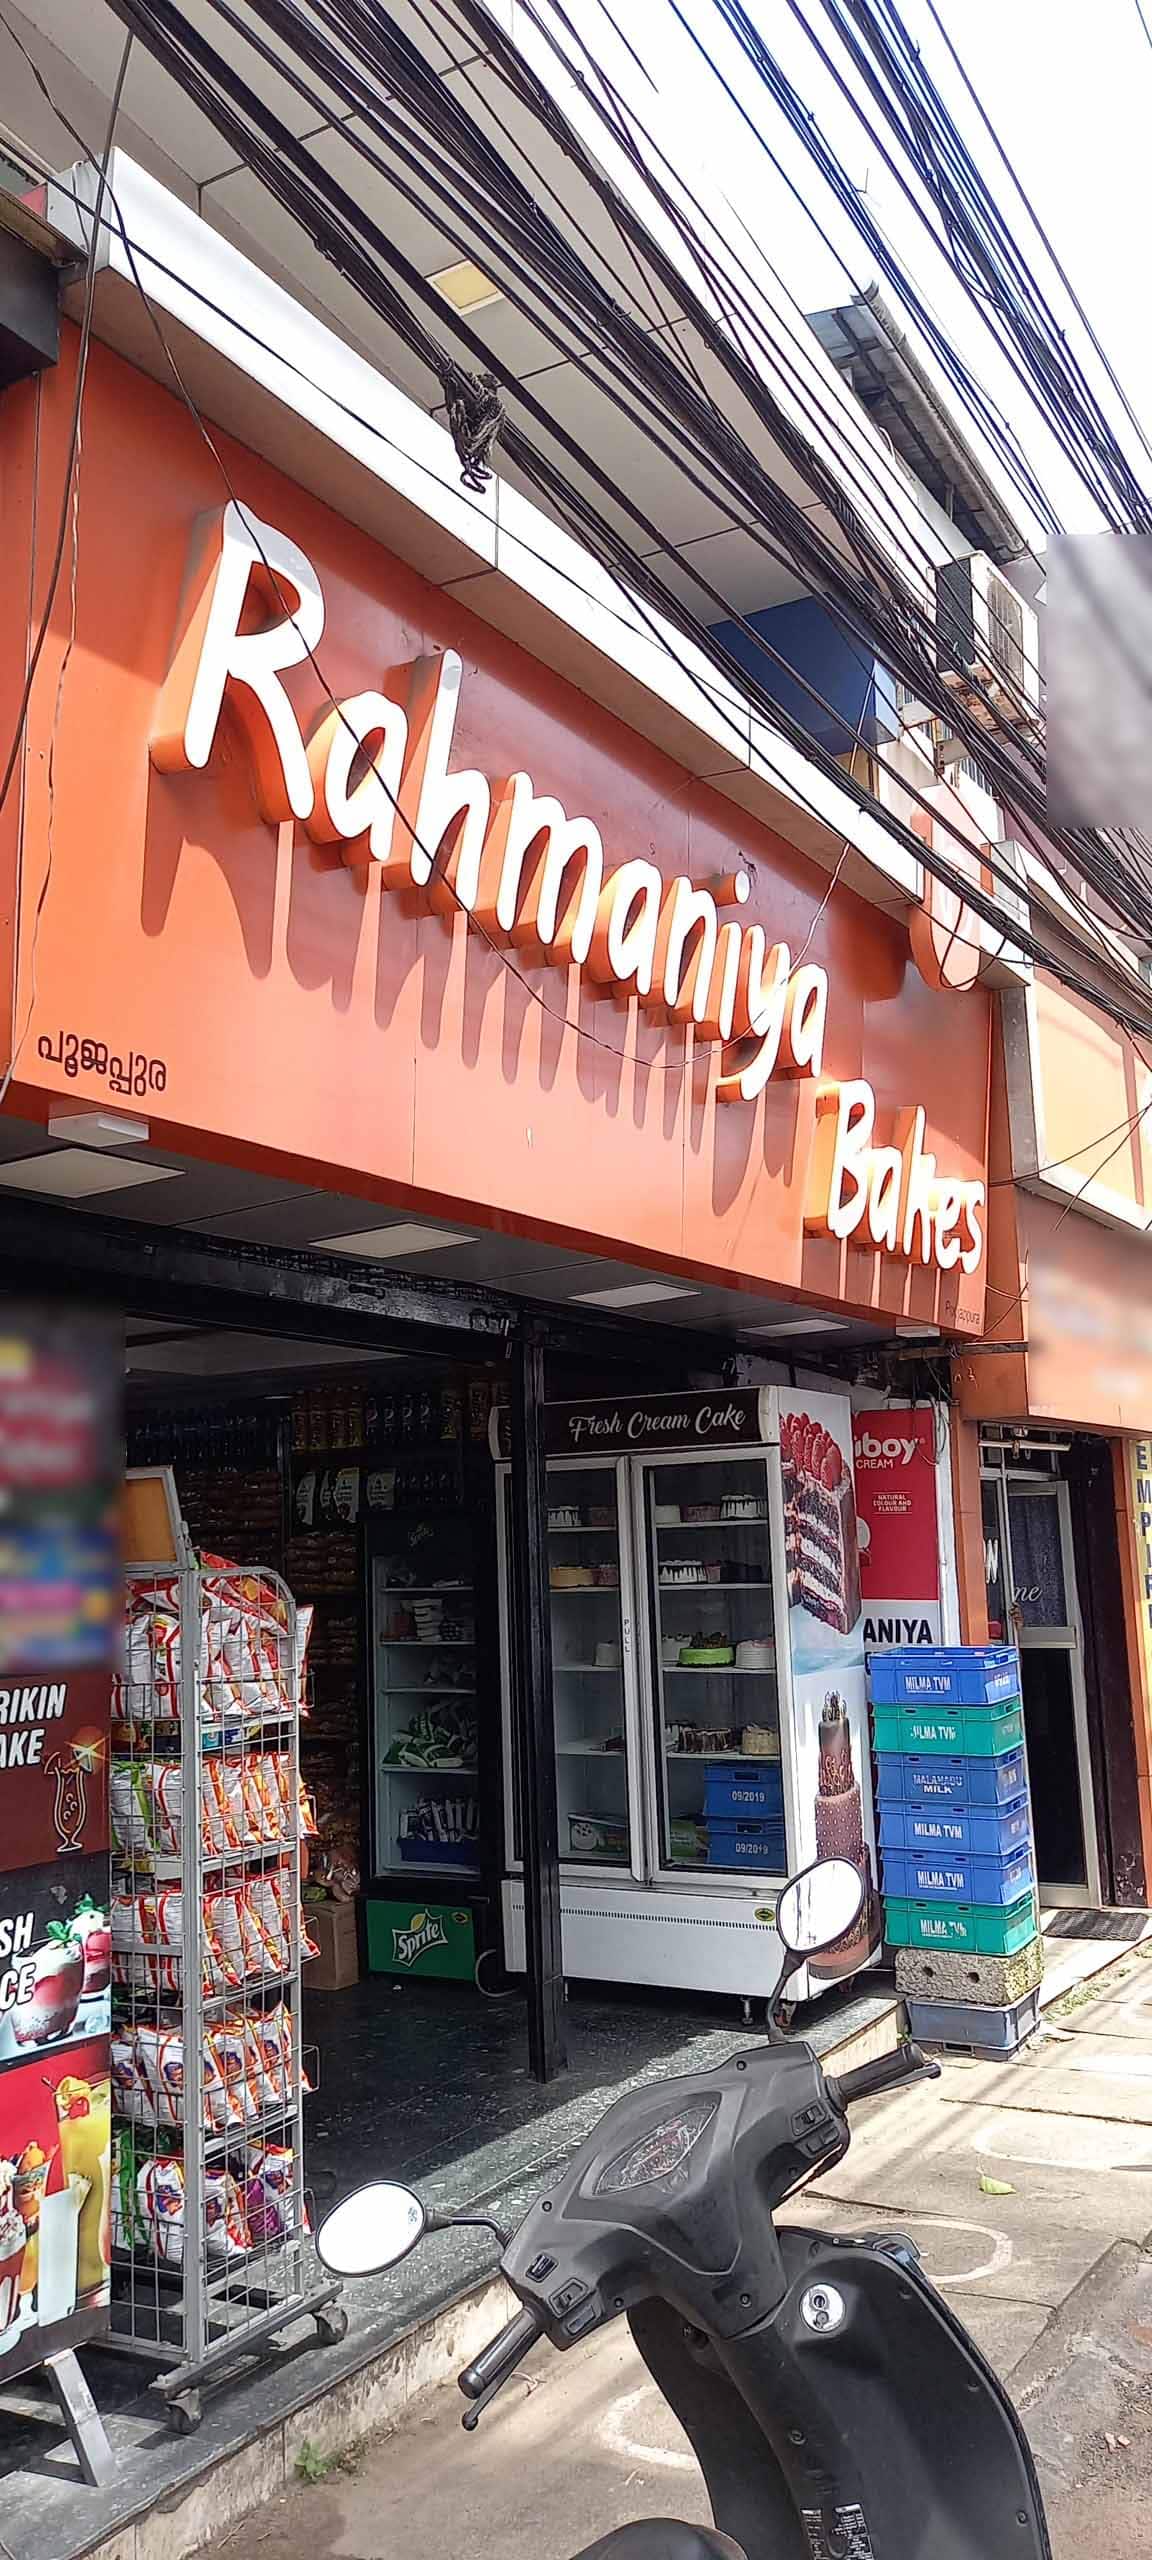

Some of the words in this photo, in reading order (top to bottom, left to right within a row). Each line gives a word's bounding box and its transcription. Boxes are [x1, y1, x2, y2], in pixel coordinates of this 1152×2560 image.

[184, 499, 829, 1102] Rahmaniya
[38, 1030, 167, 1097] പൂജപ്പുര
[827, 1078, 986, 1275] Bakes
[568, 1411, 624, 1442] Fresh
[627, 1411, 691, 1439] Cream
[695, 1403, 746, 1435] Cake
[855, 1459, 894, 1470] CREAM
[905, 1676, 932, 1691] MILMA
[933, 1677, 951, 1691] TVM
[732, 1790, 765, 1802] 09/2019
[914, 1823, 941, 1838] MILMA
[943, 1825, 962, 1839] TVM
[917, 1871, 944, 1887] MILMA
[945, 1872, 964, 1888] TVM
[920, 1920, 947, 1935] MILMA
[399, 1920, 440, 1960] Sprite
